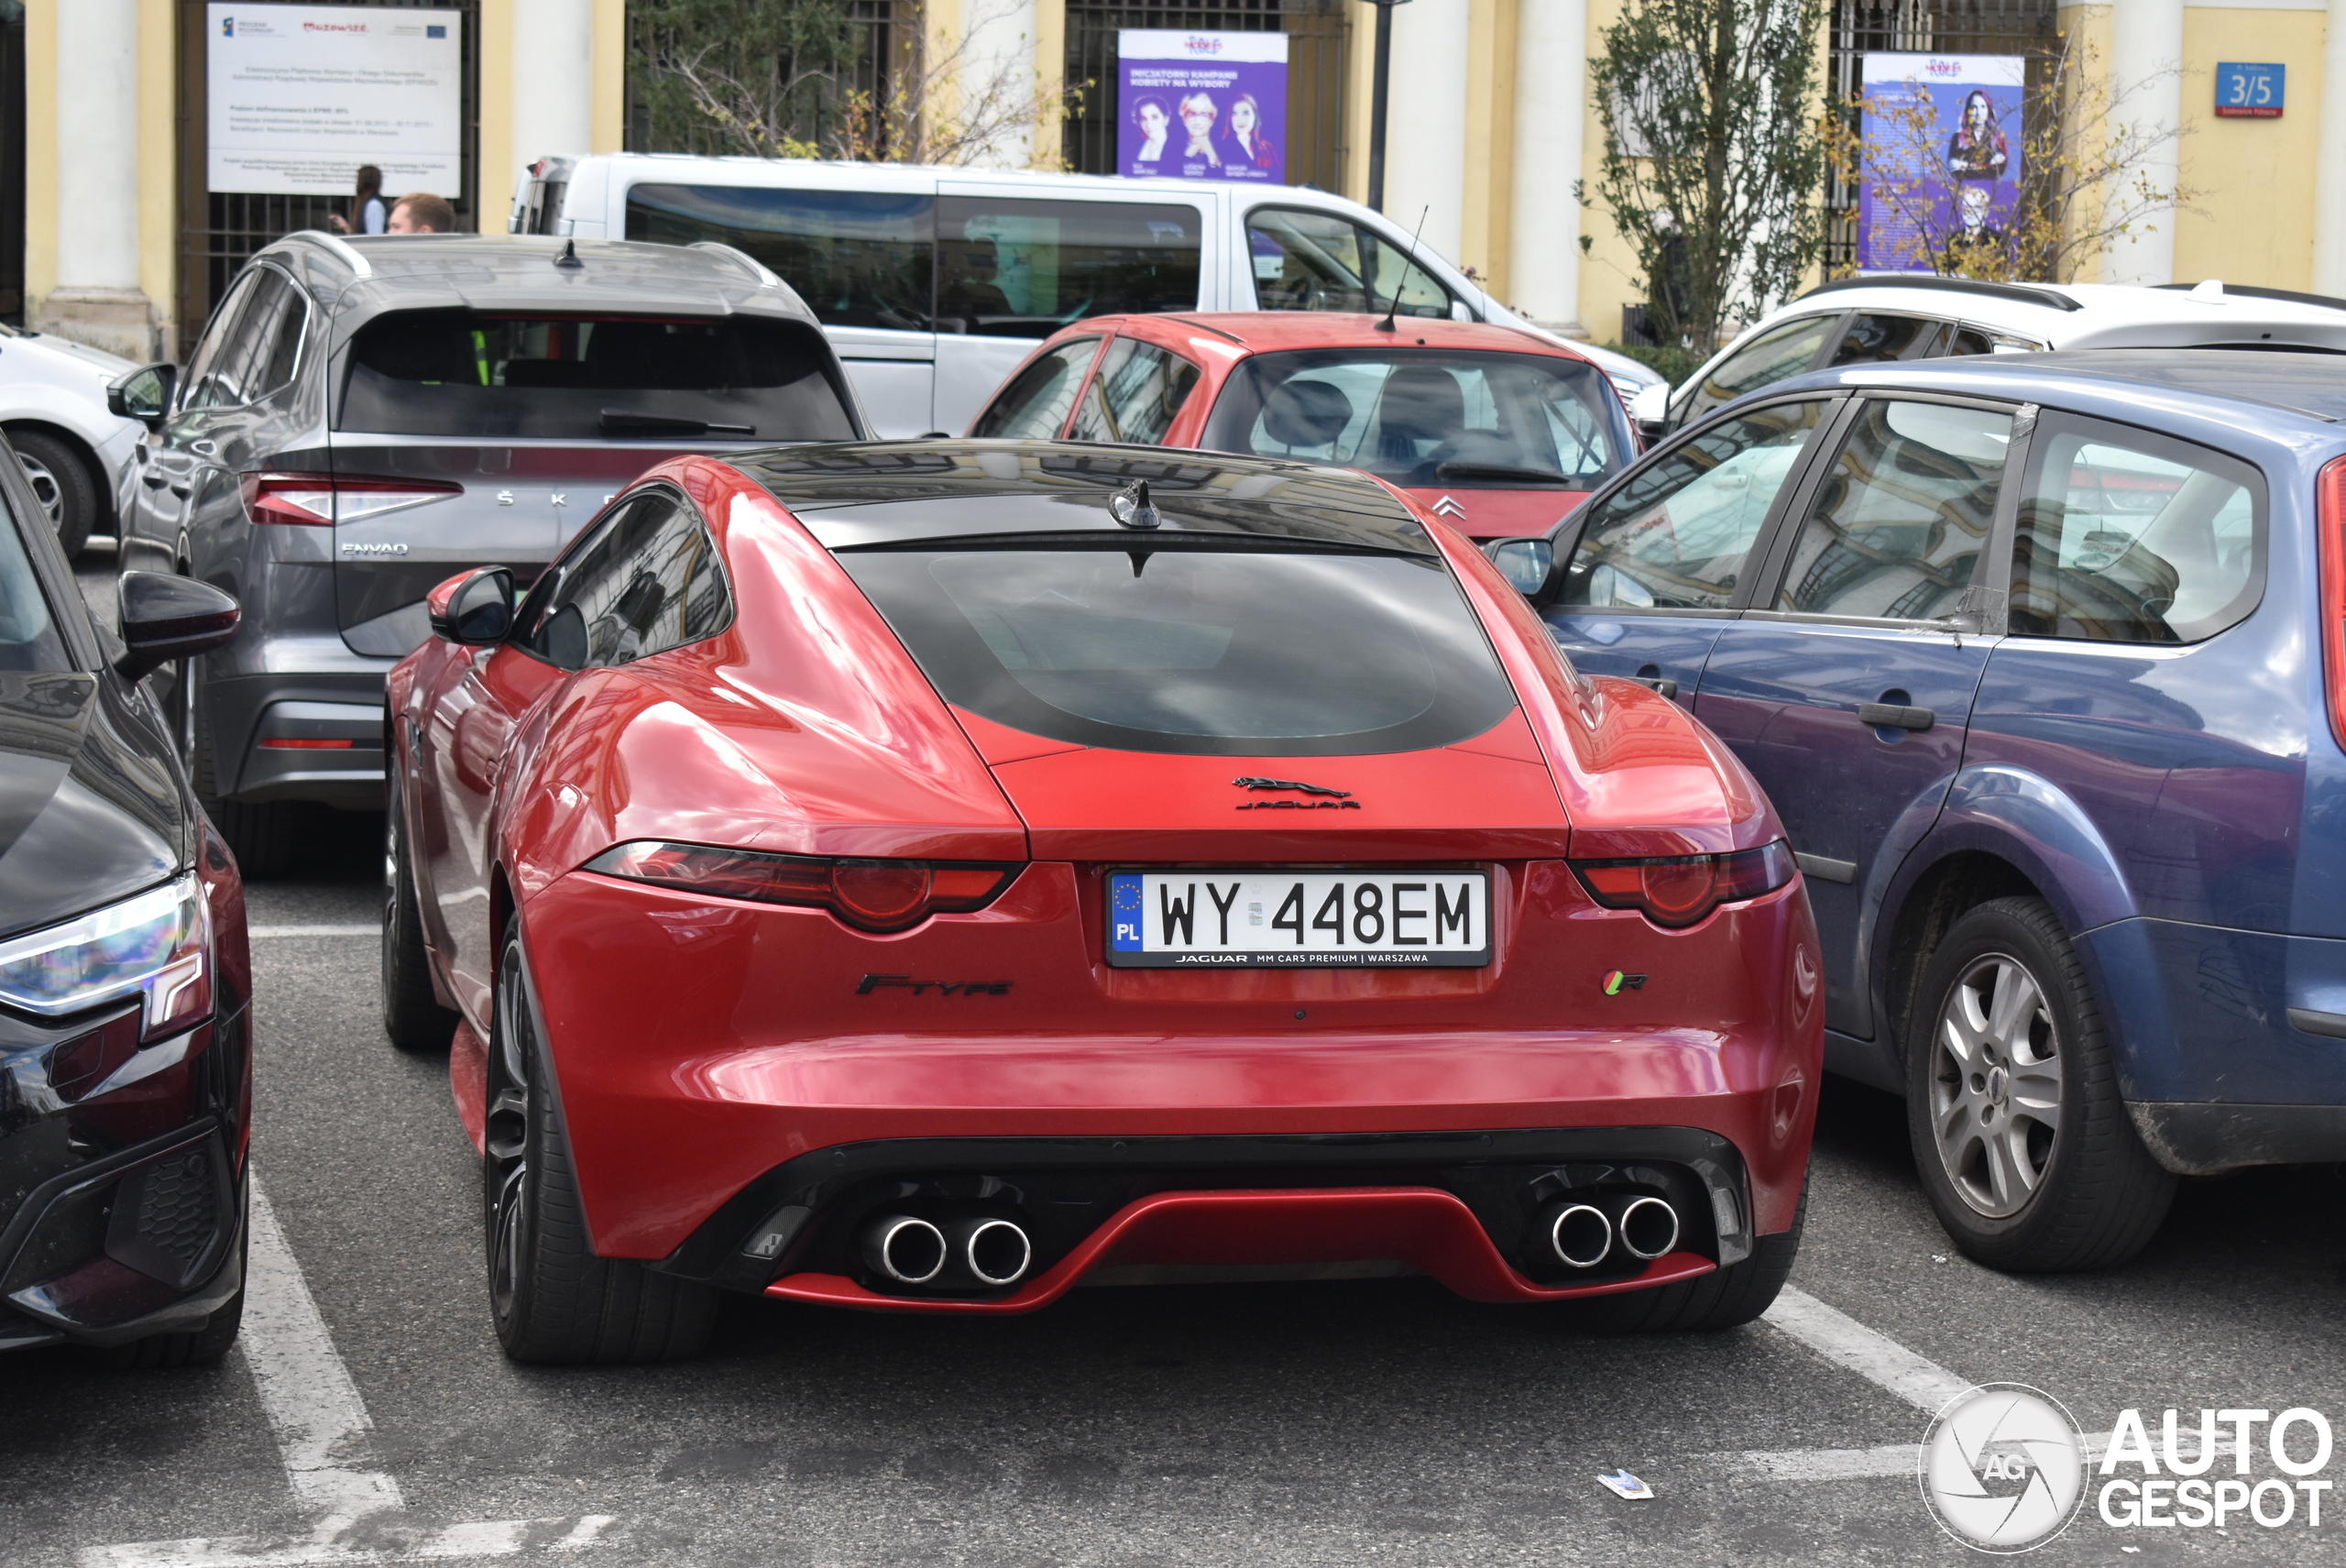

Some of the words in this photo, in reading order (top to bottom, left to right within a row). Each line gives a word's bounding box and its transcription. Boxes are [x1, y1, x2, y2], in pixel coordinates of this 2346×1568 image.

[1130, 69, 1189, 79] INICJATORKI
[1190, 71, 1238, 81] KAMPANII
[1130, 79, 1171, 87] KOBIETY
[1173, 79, 1188, 88] NA
[1189, 80, 1232, 89] WYBORY
[2230, 75, 2271, 106] 3/5
[343, 543, 409, 555] ENYAQ
[1235, 800, 1361, 810] JAGUAR
[1159, 883, 1241, 945] WY
[1271, 883, 1471, 945] 448EM
[1116, 924, 1139, 940] PL
[1310, 955, 1357, 963] PREMIUM
[1367, 955, 1429, 963] WARSZAWA
